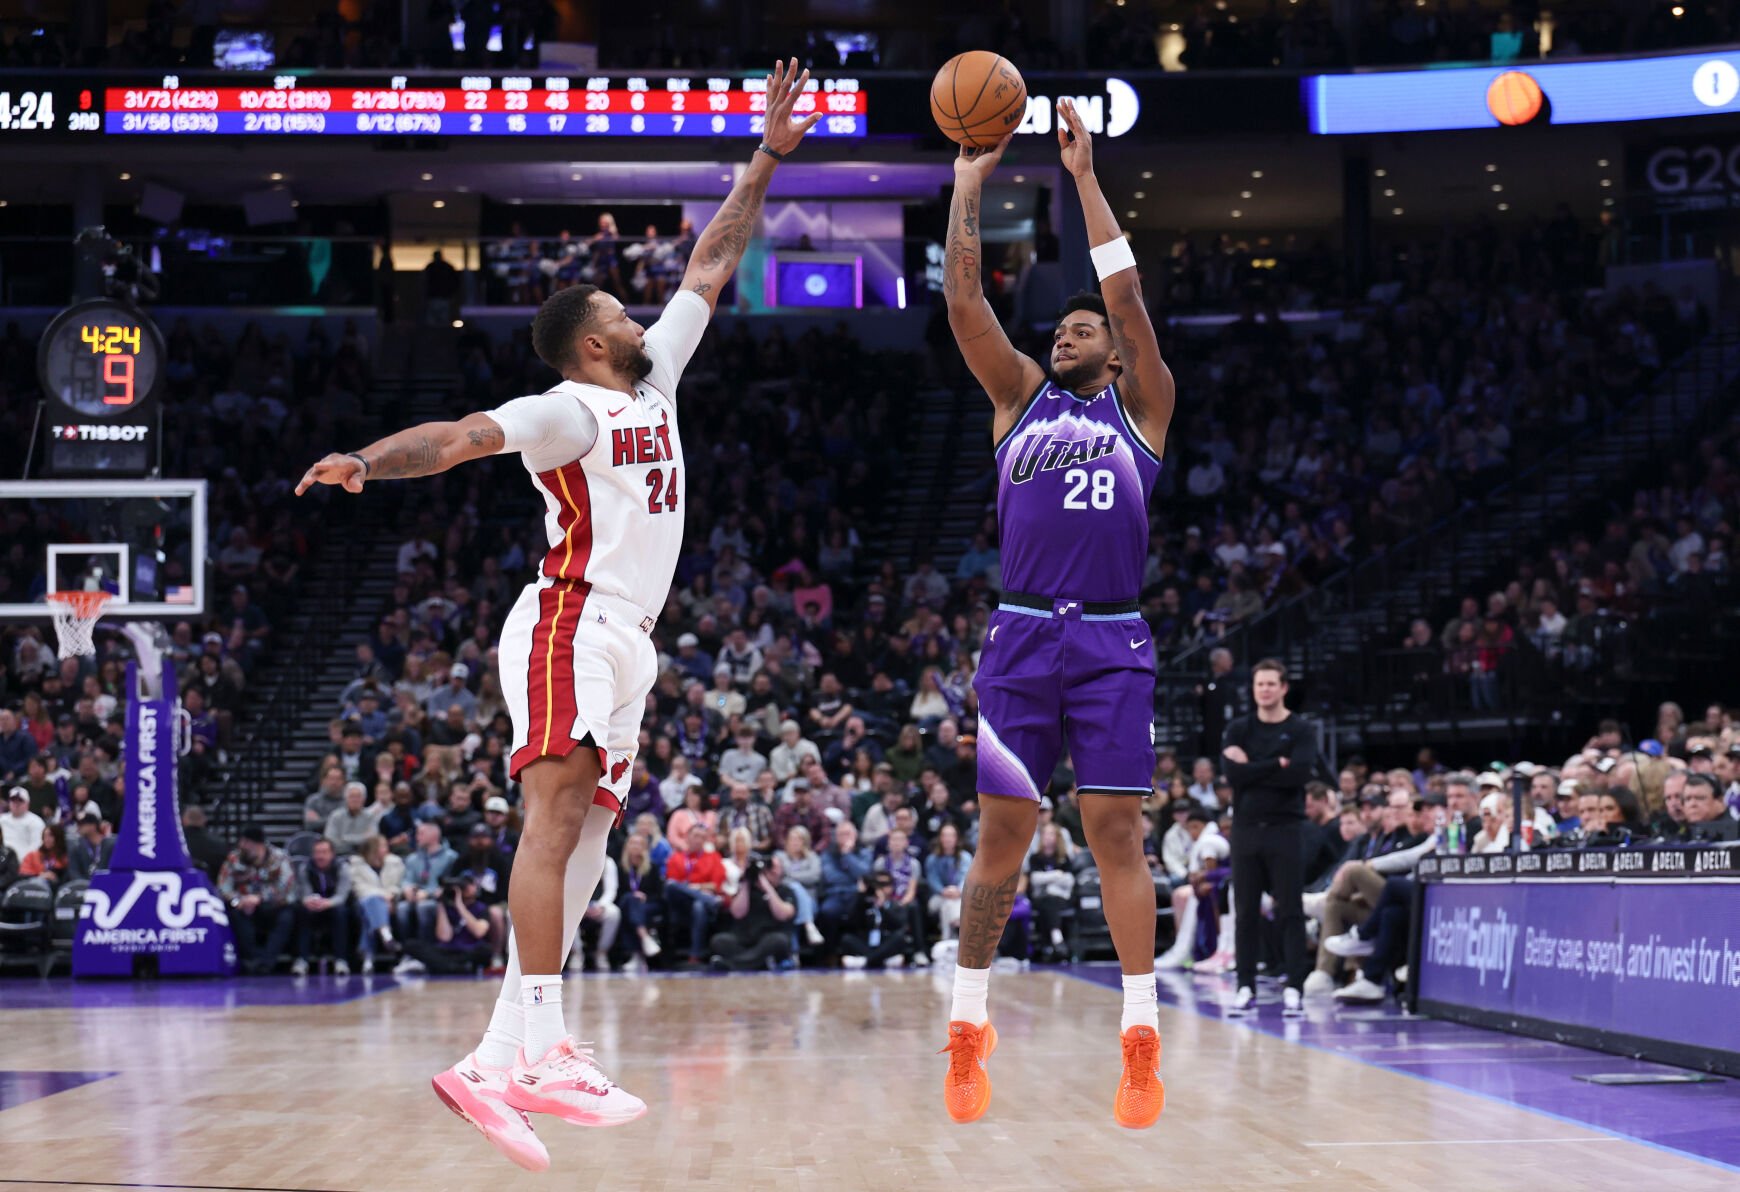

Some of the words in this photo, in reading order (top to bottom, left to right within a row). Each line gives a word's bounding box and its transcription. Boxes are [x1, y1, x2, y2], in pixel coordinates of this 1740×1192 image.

[68, 112, 99, 131] 3RD
[124, 91, 171, 108] 31/73
[172, 91, 219, 110] (42%)
[239, 91, 287, 108] 10/32
[464, 92, 487, 110] 22
[504, 92, 528, 110] 23
[545, 92, 569, 110] 45
[585, 92, 610, 111] 20
[671, 93, 685, 111] 2
[708, 93, 729, 111] 10
[826, 93, 857, 112] 102
[244, 113, 282, 131] 2/13
[356, 113, 394, 131] 8/12
[469, 114, 483, 132] 2
[547, 114, 567, 132] 17
[671, 115, 685, 133] 7
[711, 115, 726, 133] 9
[826, 115, 857, 134] 125
[81, 325, 141, 355] 4:24
[103, 354, 135, 405] 9
[76, 425, 149, 441] TISSOT
[612, 409, 673, 466] HEAT
[1010, 432, 1121, 485] UTAH
[645, 467, 678, 514] 24
[1063, 468, 1116, 511] 28
[138, 704, 158, 764] FIRST
[138, 765, 157, 859] AMERICA
[1619, 852, 1644, 870] DELTA
[1659, 852, 1685, 870] DELTA
[1702, 851, 1731, 870] DELTA
[83, 928, 158, 944] AMERICA
[158, 928, 208, 944] FIRST
[1427, 906, 1518, 990] HealthEquity
[1524, 926, 1557, 967] Better
[1557, 938, 1584, 977] save,
[1586, 932, 1625, 982] spend,
[1627, 934, 1653, 978] and
[1653, 934, 1696, 982] invest
[1698, 936, 1720, 984] for
